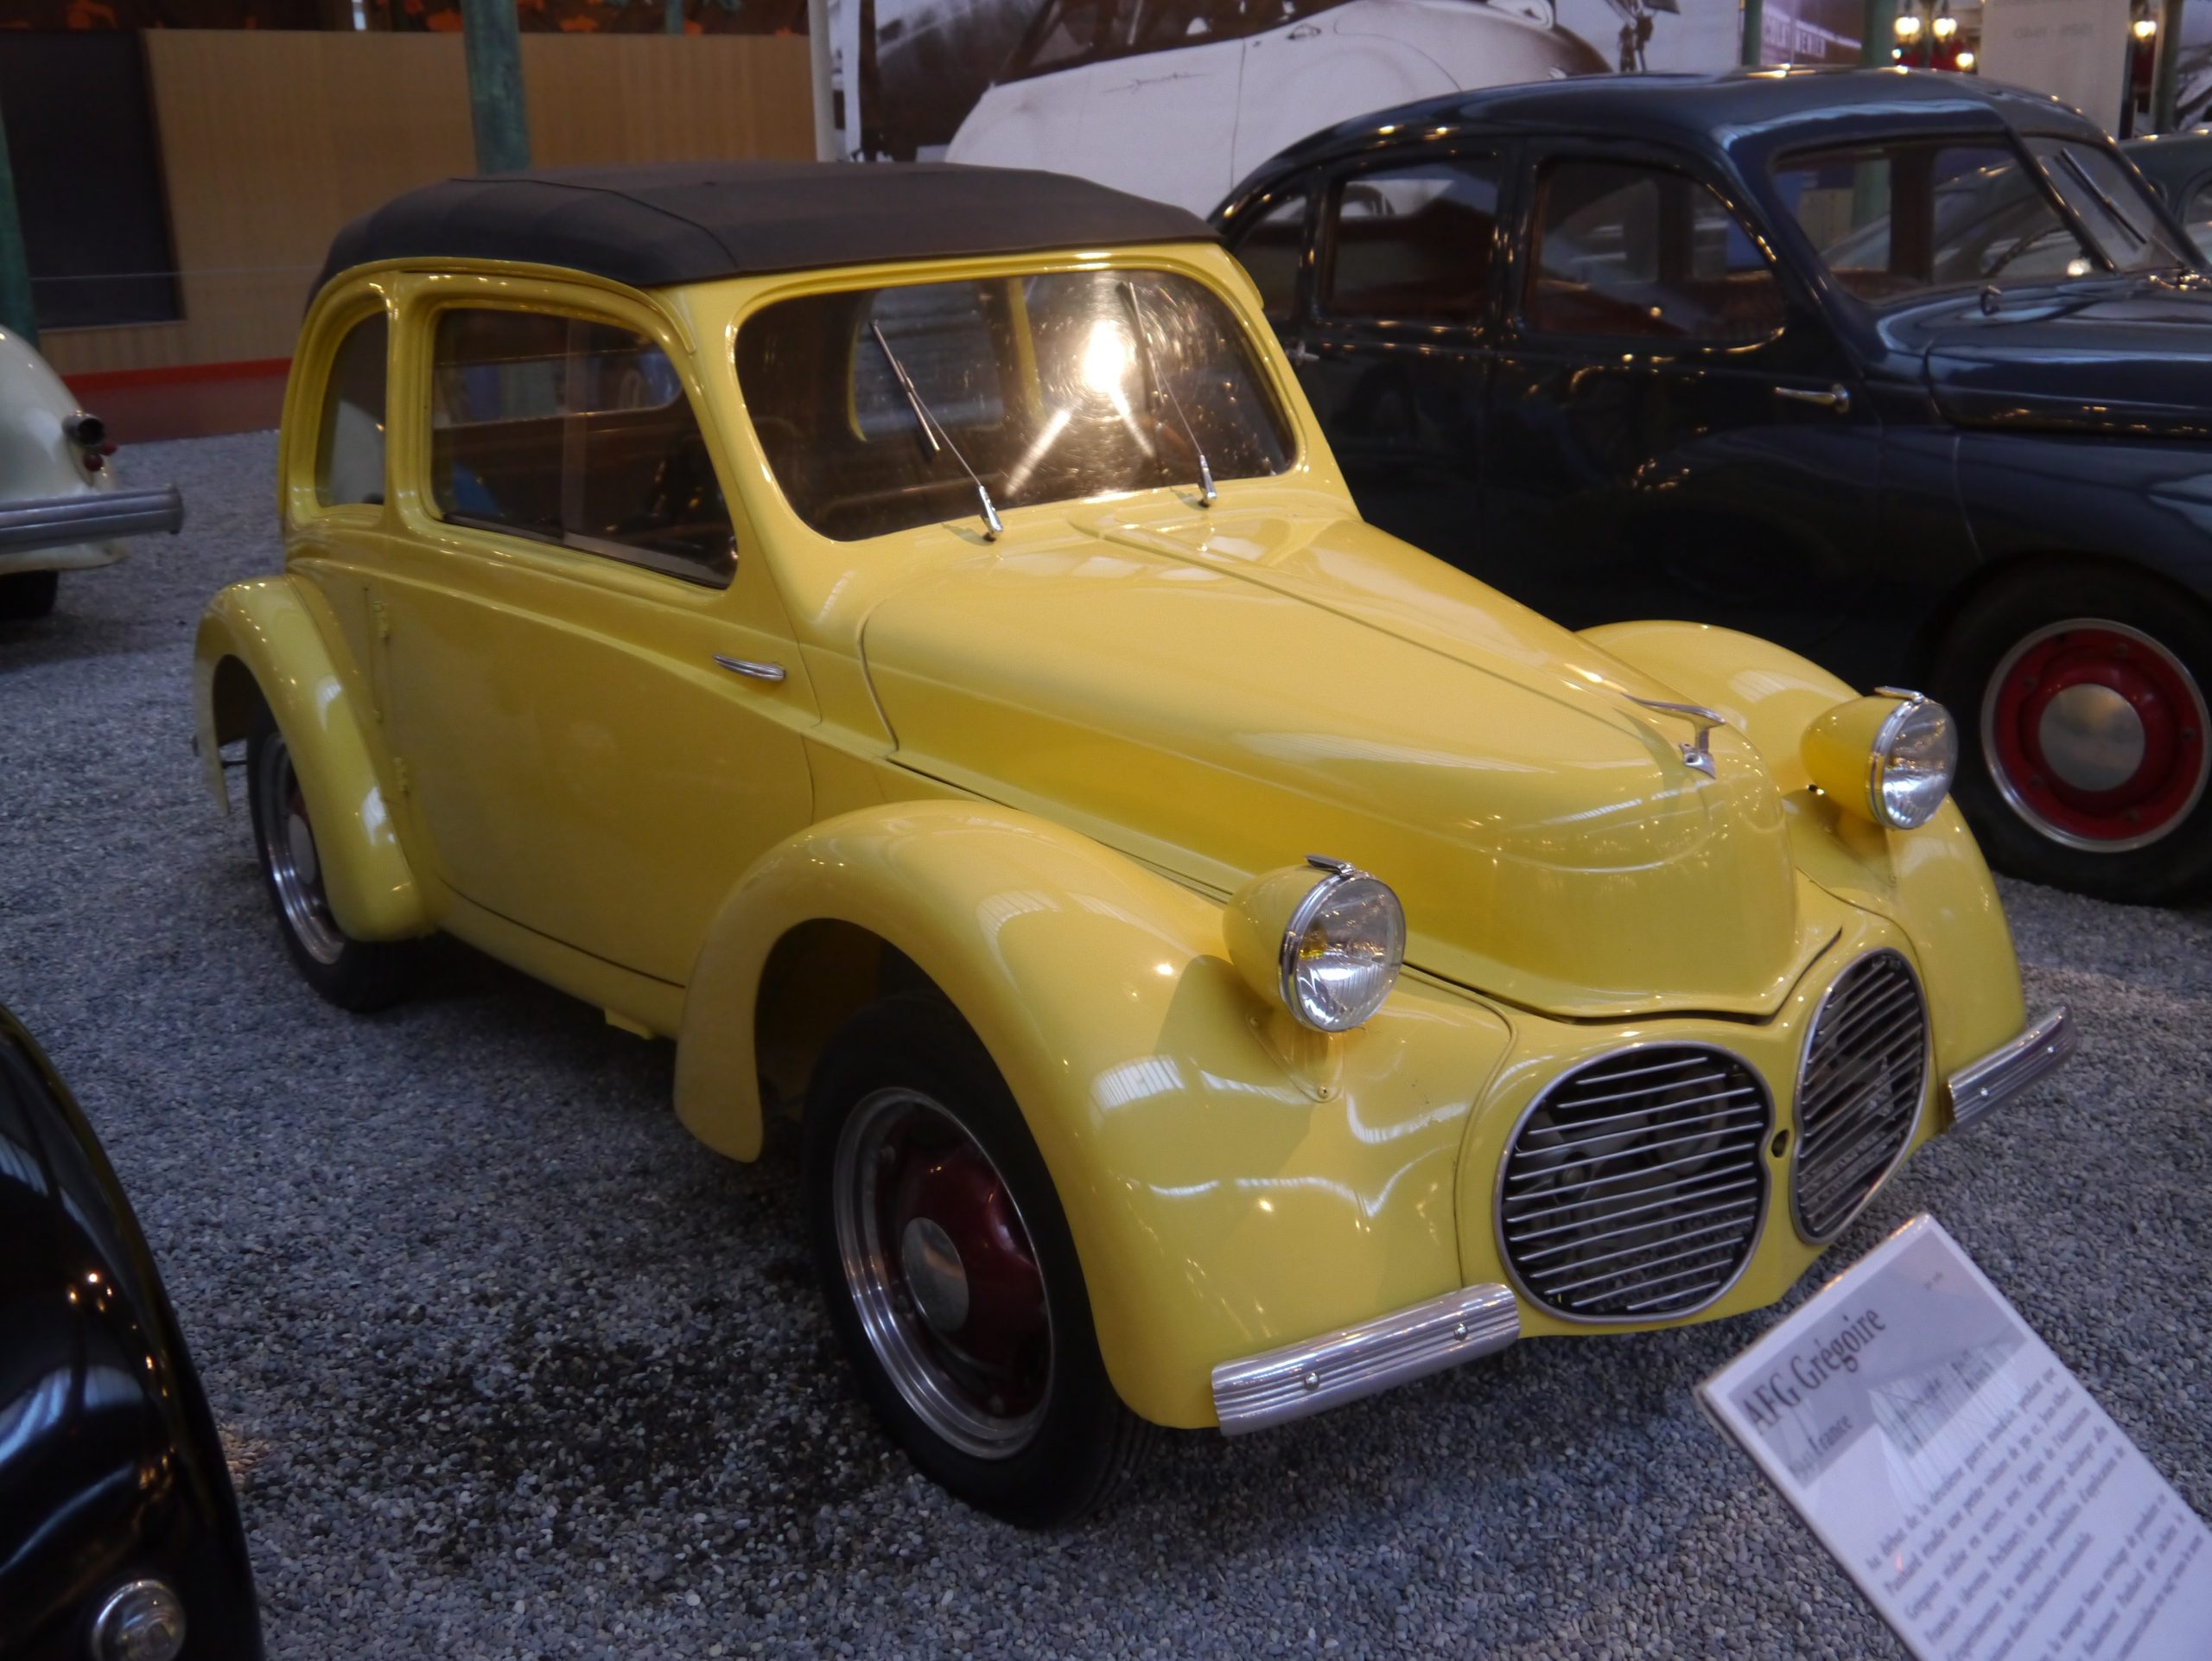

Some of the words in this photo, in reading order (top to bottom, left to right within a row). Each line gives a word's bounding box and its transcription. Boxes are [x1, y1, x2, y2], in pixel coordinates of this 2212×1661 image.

[1740, 1371, 1801, 1435] AFG
[1789, 1308, 1886, 1391] Grégoire
[1808, 1415, 1853, 1456] France
